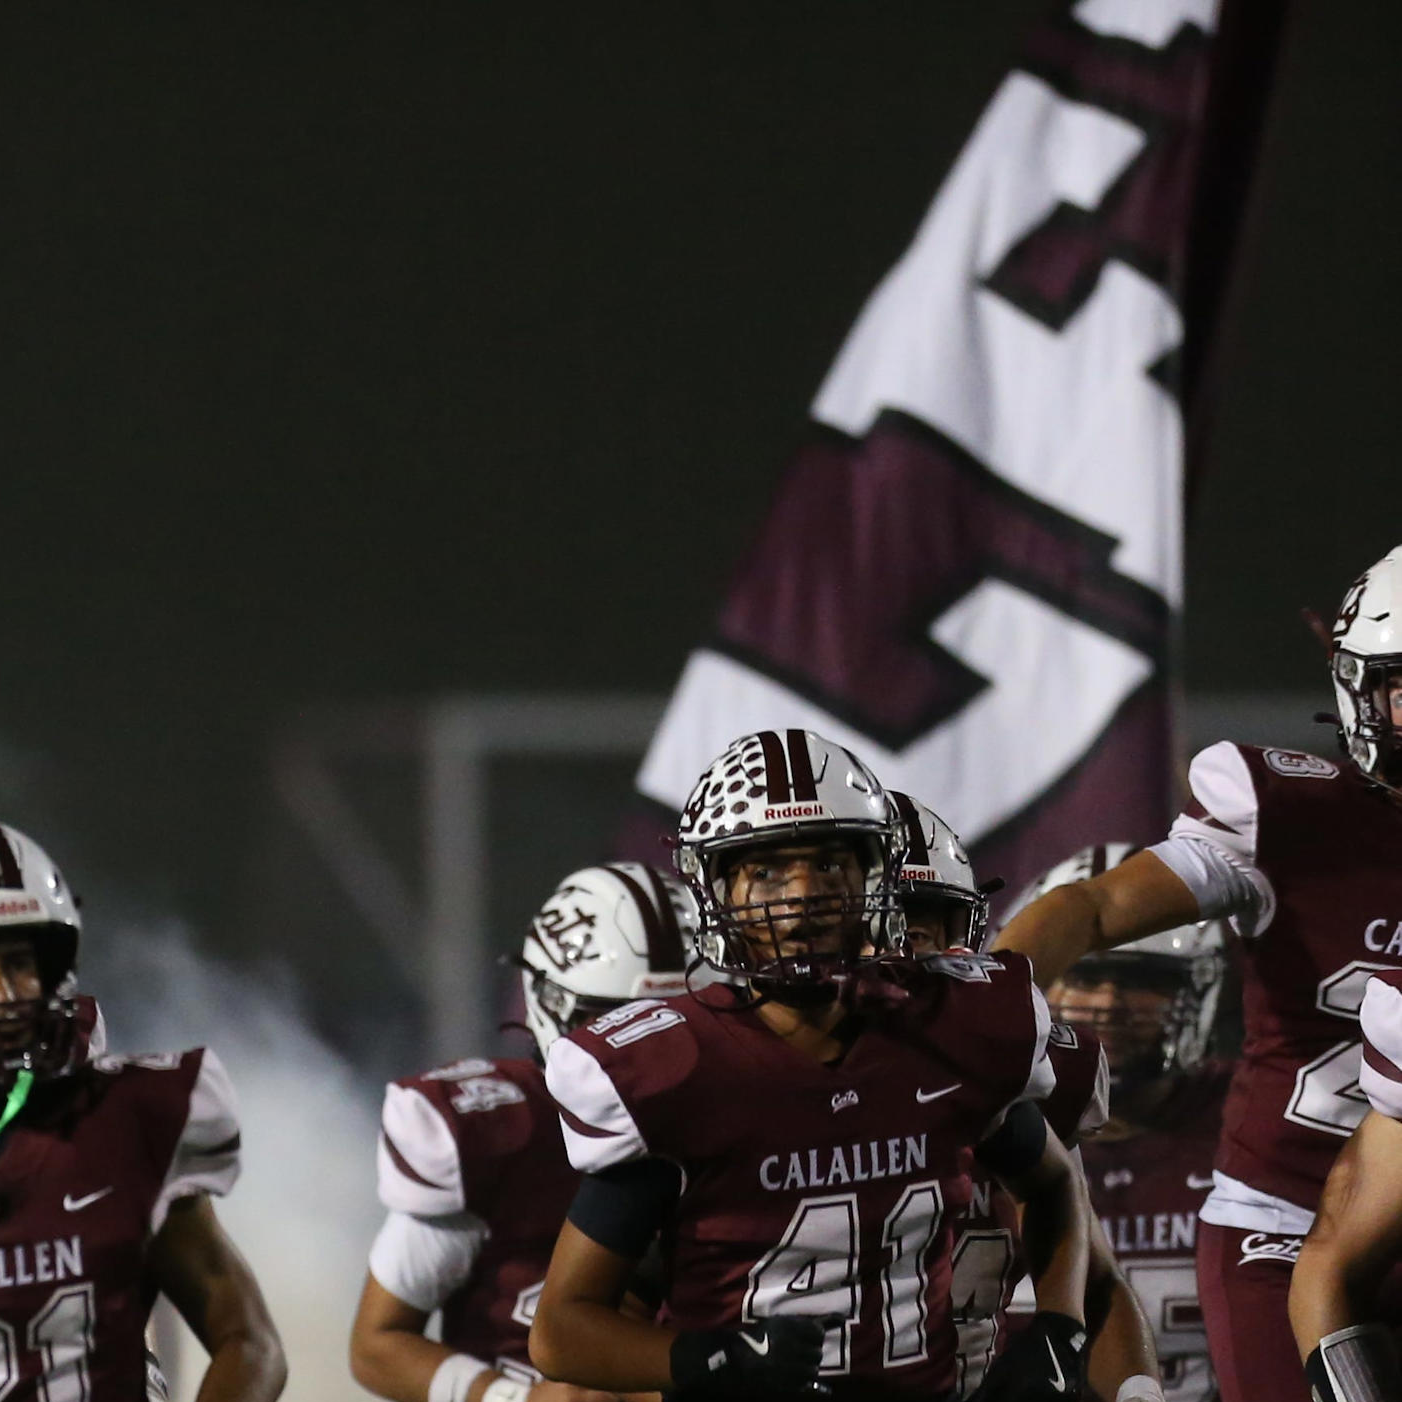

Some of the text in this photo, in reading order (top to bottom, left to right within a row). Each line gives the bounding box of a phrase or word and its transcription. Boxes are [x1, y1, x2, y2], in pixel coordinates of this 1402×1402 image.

[764, 802, 824, 821] Riddell
[900, 869, 937, 881] ddell
[831, 1090, 860, 1113] Cats
[759, 1134, 928, 1191] CALALLEN
[1104, 1213, 1197, 1253] ALLEN
[742, 1179, 945, 1376] 41
